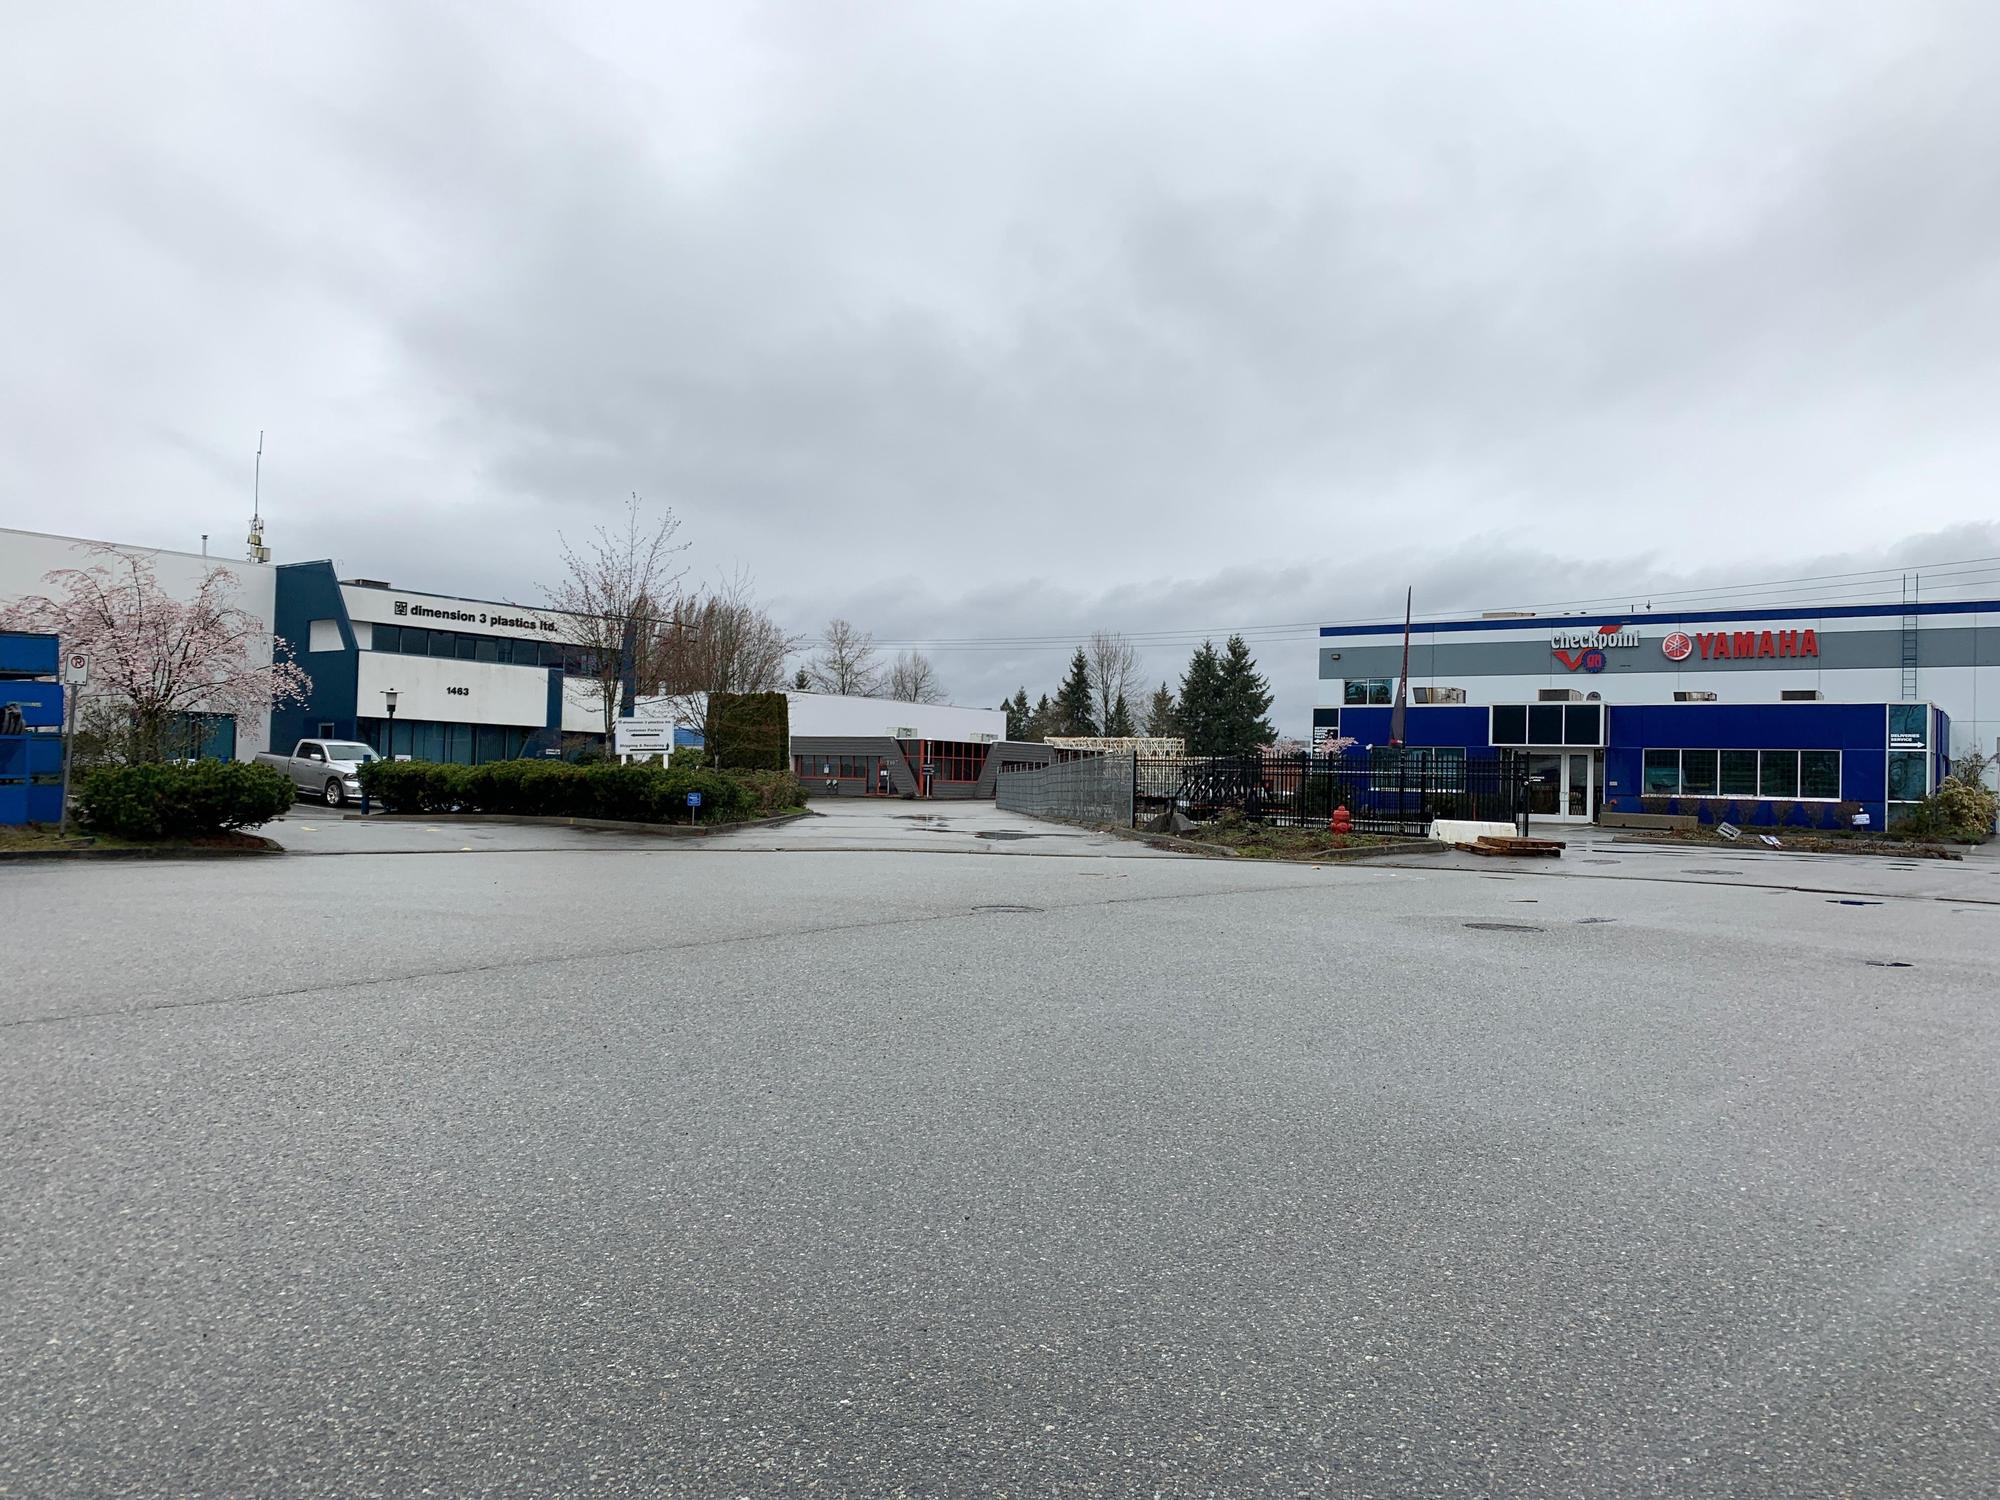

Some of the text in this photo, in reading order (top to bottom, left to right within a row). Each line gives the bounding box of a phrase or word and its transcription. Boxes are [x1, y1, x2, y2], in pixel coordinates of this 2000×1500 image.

[411, 605, 475, 622] dimension
[479, 613, 487, 623] 3
[490, 615, 536, 630] plastics
[1551, 630, 1640, 650] checkpoint
[1696, 629, 1819, 660] YAMAHA
[446, 687, 469, 696] 1463
